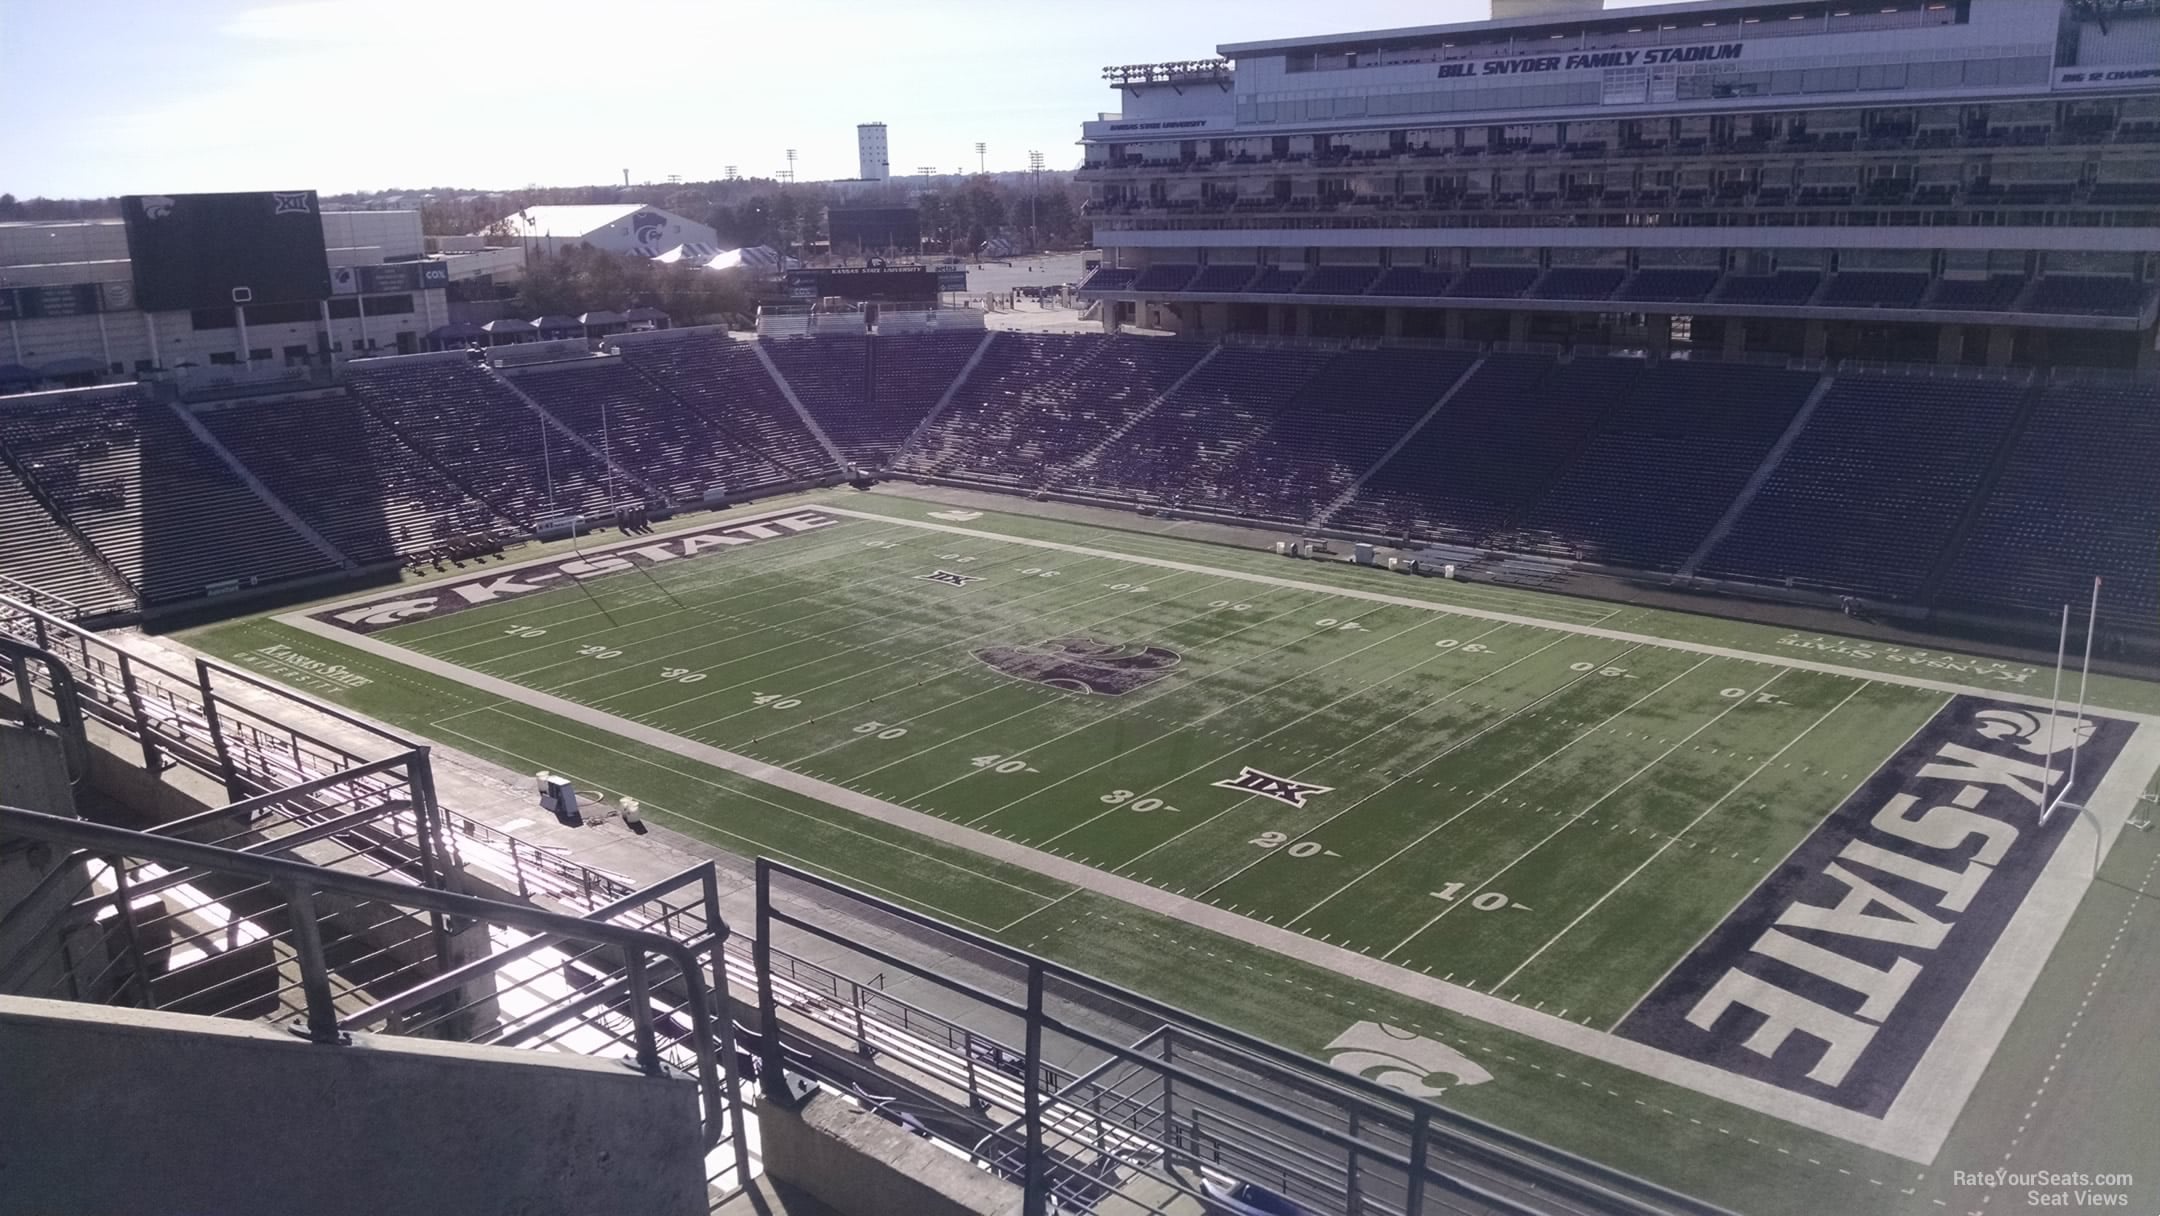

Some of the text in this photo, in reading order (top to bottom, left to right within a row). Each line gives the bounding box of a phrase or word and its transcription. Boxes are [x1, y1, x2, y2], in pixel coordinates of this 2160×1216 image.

[1438, 43, 1744, 79] BILL SNYDER FAMILY STADIUM
[425, 270, 446, 280] COX
[452, 513, 838, 603] K-STATE
[1208, 600, 1252, 611] 50
[1315, 618, 1363, 631] 40
[1435, 639, 1489, 652] 30
[661, 667, 707, 683] 30
[1570, 662, 1629, 678] 20
[754, 692, 802, 710] 40
[1720, 687, 1779, 704] 10
[853, 721, 908, 740] 50
[971, 754, 1027, 774] 40
[1100, 789, 1164, 812] 30
[1249, 831, 1323, 858] 20
[1430, 881, 1510, 911] 10
[1685, 742, 2064, 1088] K-STATE
